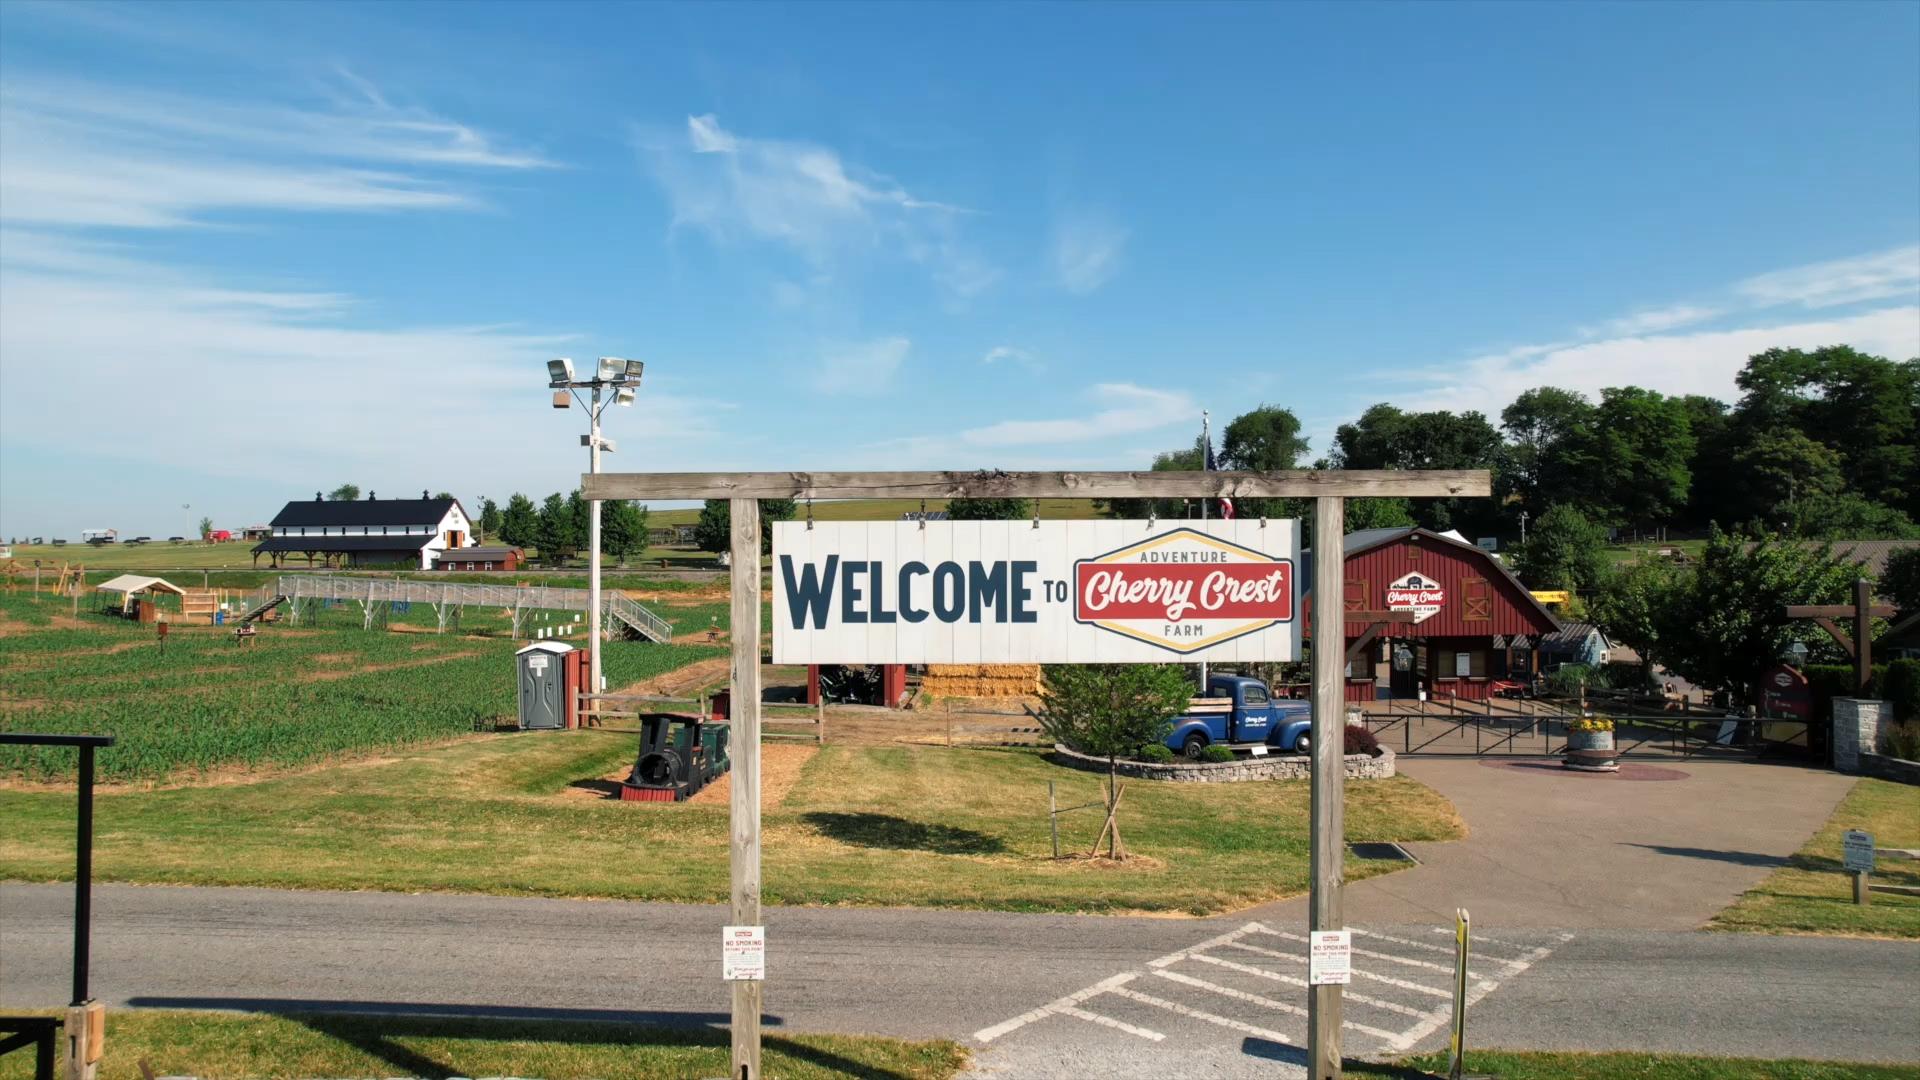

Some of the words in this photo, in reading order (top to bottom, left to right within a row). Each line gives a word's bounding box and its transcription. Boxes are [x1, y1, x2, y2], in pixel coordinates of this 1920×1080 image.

[1140, 551, 1228, 564] ADVENTURE
[780, 554, 1038, 630] WELCOME
[1042, 580, 1068, 603] TO
[1085, 570, 1196, 621] Cherry
[1199, 569, 1282, 612] Crest
[1387, 591, 1419, 606] Cherry
[1164, 625, 1204, 636] FARM
